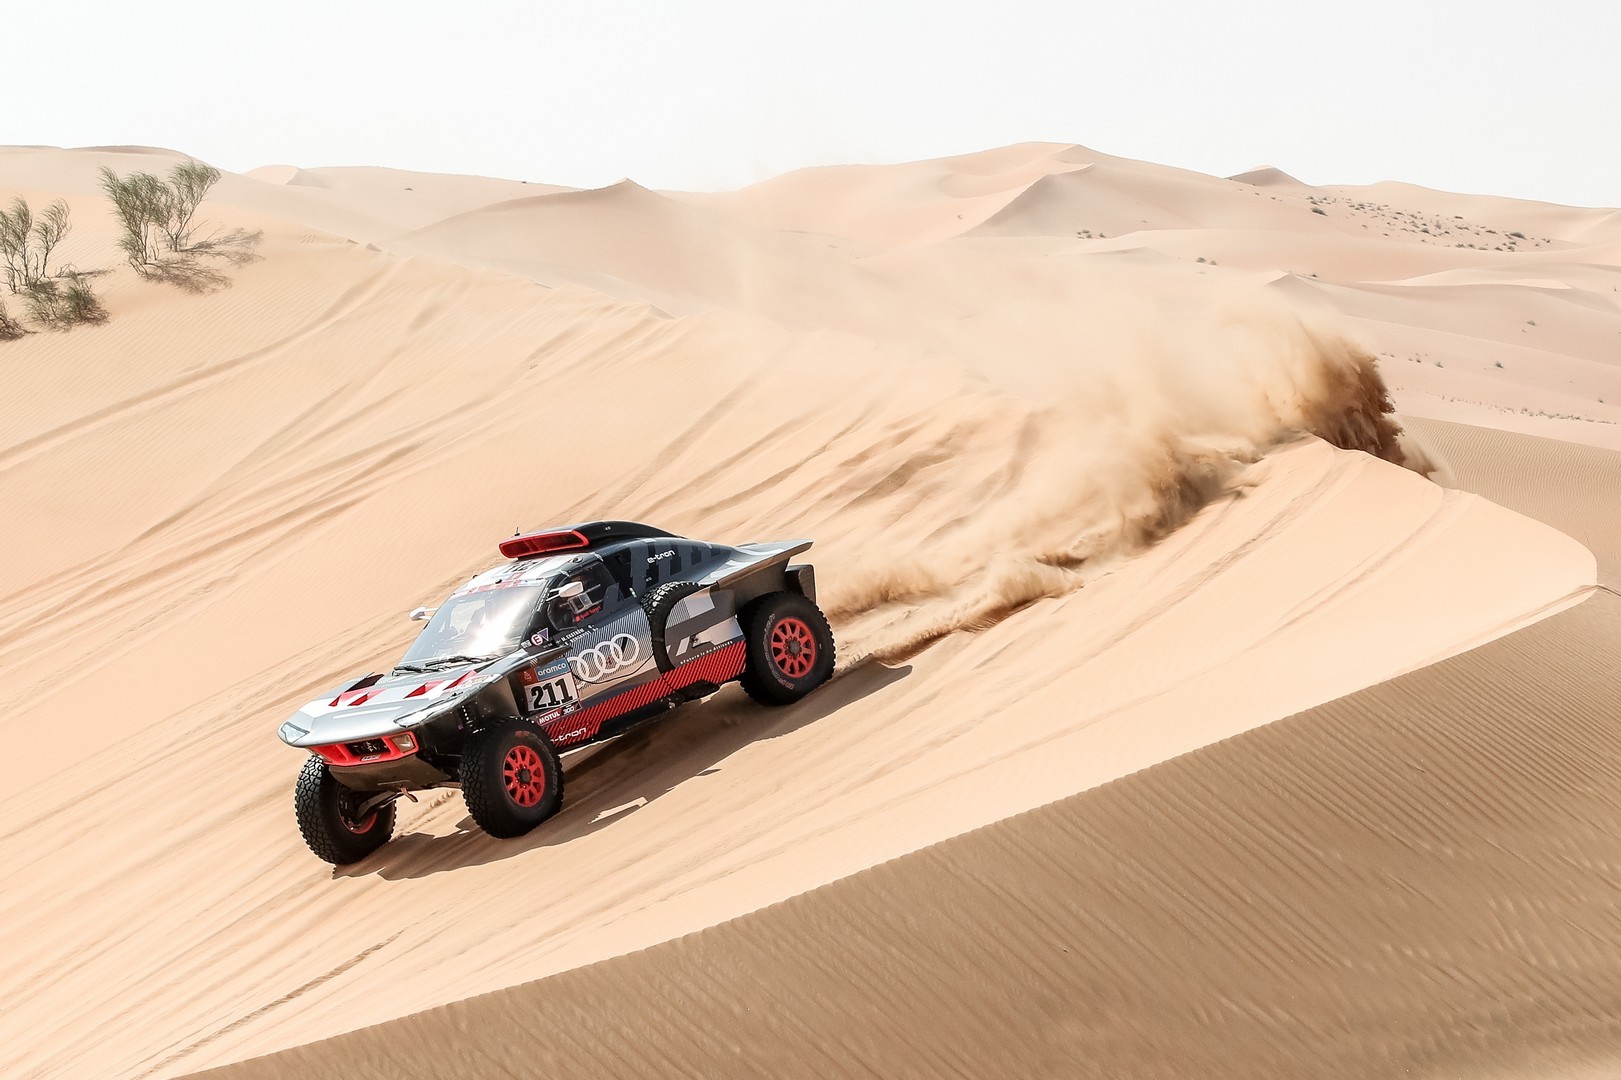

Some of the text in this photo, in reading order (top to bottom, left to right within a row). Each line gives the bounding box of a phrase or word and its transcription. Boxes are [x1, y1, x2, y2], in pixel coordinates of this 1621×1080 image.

[647, 549, 676, 564] e-tron
[537, 662, 567, 676] aramco
[530, 678, 573, 709] 211
[538, 711, 561, 724] MOTUL
